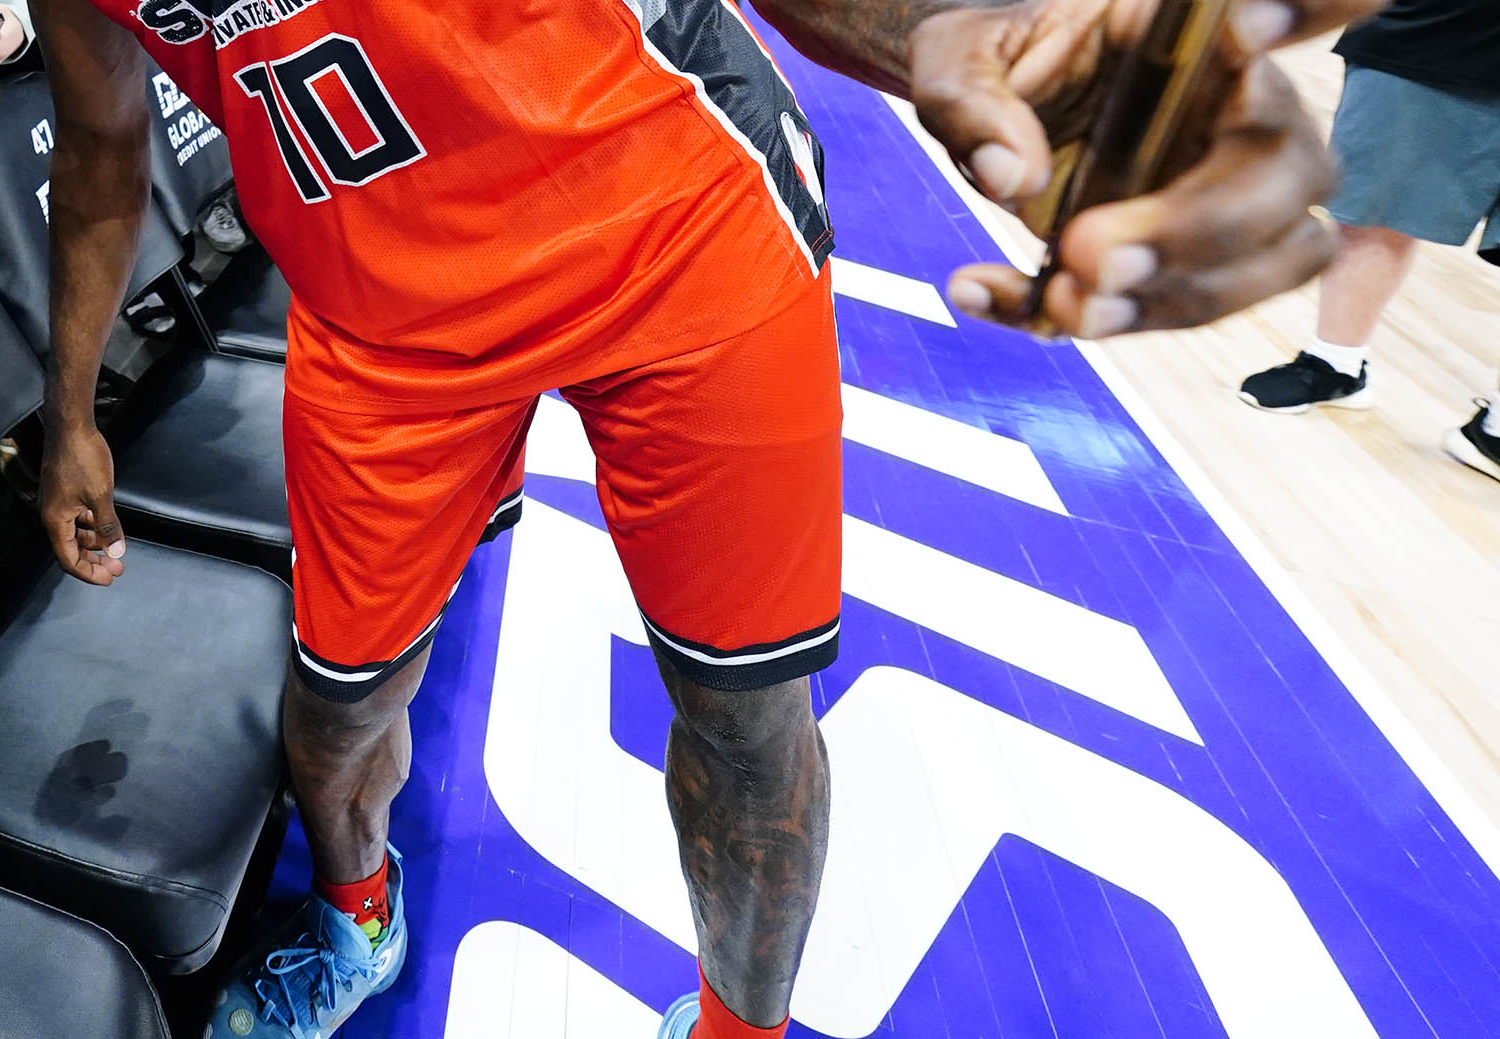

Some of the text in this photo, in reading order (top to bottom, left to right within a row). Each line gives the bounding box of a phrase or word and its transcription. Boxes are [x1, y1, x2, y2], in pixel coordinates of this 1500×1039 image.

[30, 118, 55, 154] 47
[167, 109, 211, 150] GLOBA
[233, 32, 428, 205] 10
